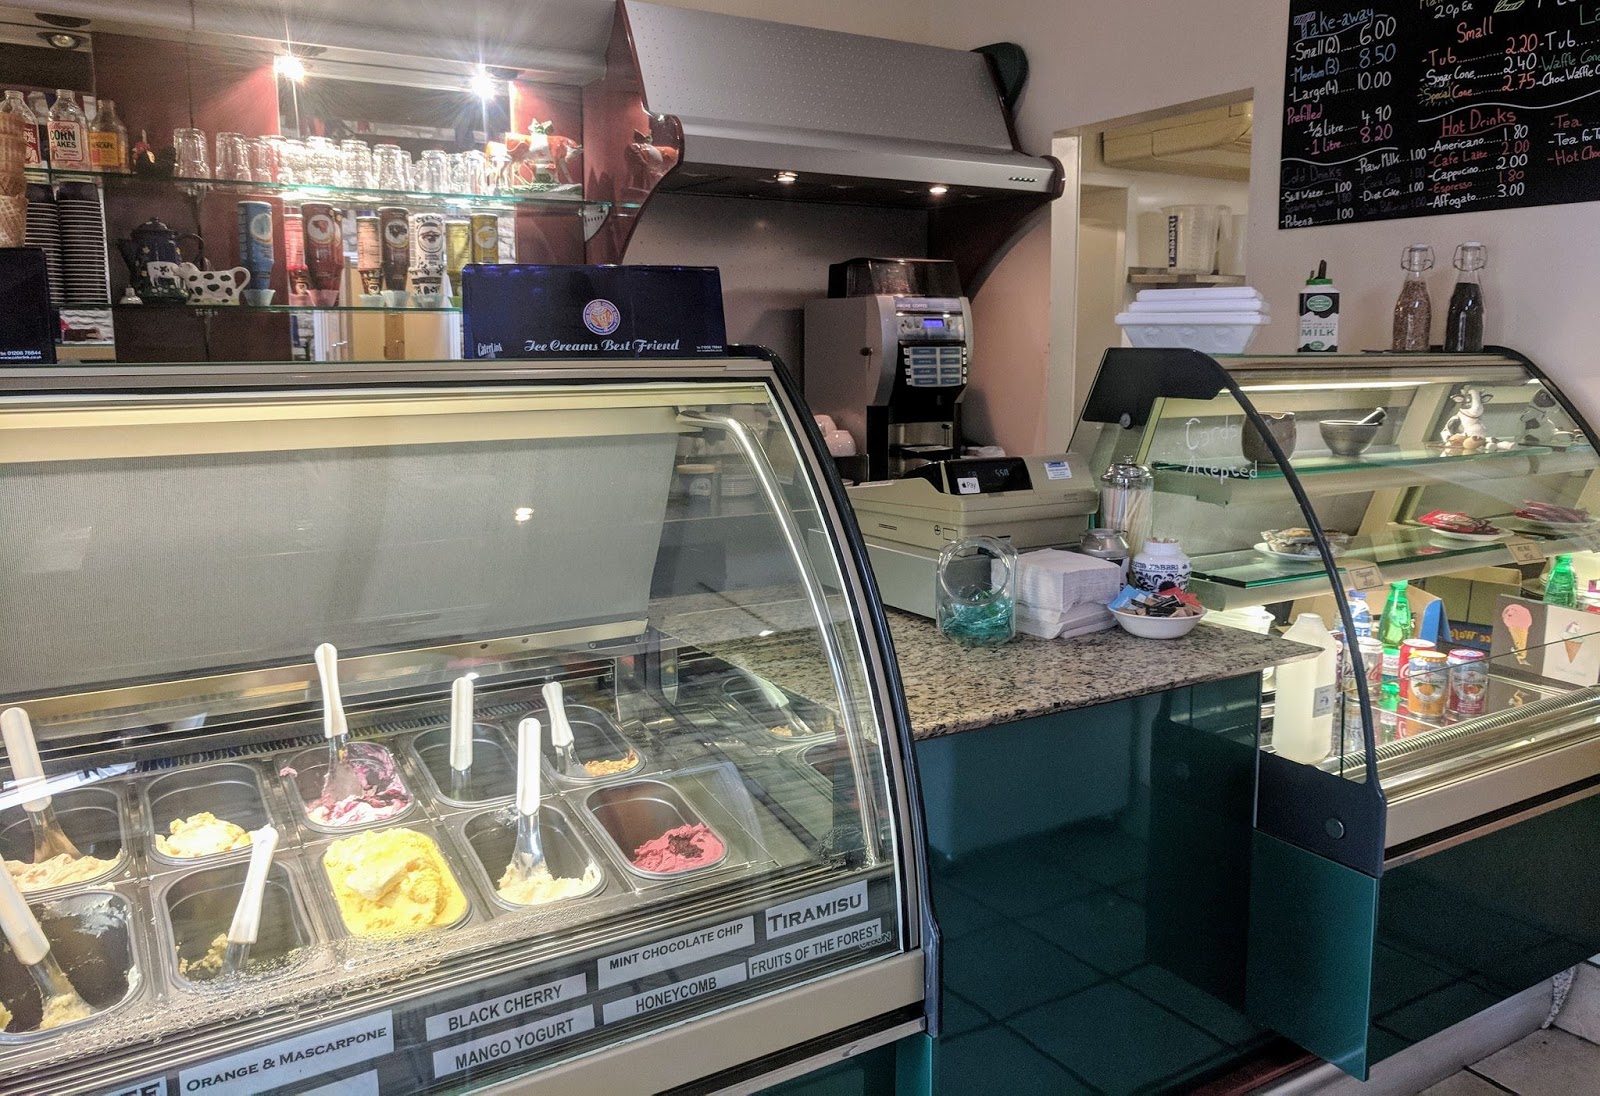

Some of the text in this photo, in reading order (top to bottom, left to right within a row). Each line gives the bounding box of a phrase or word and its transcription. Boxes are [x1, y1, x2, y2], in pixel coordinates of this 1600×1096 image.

[1434, 4, 1460, 19] 20p
[1360, 16, 1397, 45] 6.00
[1456, 15, 1494, 43] Small
[1544, 29, 1576, 51] Tub
[1359, 42, 1397, 69] 8.50
[1428, 33, 1538, 66] Tub 2.20
[1541, 51, 1576, 72] Waffle
[1357, 71, 1392, 91] 10.00
[1426, 52, 1538, 87] Sugar Cone 2.40
[1541, 71, 1566, 87] Choc
[1565, 64, 1594, 81] Waffle
[1452, 84, 1473, 99] Cone
[1501, 70, 1536, 92] 2.75
[1286, 103, 1323, 126] Prefilled
[1361, 104, 1392, 126] 4.90
[1441, 107, 1517, 138] Hot Drinks
[1554, 113, 1583, 129] Tea
[49, 129, 76, 141] CORN
[1322, 137, 1342, 153] litre
[1359, 123, 1393, 144] 8.20
[1433, 124, 1529, 153] Americano 1.80
[1553, 132, 1579, 147] Tea
[1581, 128, 1594, 142] for
[1359, 148, 1427, 175] Raw Milk 1.00
[1433, 138, 1530, 168] Cafe Latte 2.00
[1554, 149, 1580, 166] Hot
[1432, 153, 1529, 183] Cappucino 2.00
[1433, 168, 1525, 195] Espresso 1.80
[1300, 188, 1324, 199] Water
[1335, 181, 1353, 194] 1.00
[1363, 181, 1425, 202] Diet Coke 1.00
[1432, 182, 1526, 209] Affogato 3.00
[1284, 214, 1314, 229] Ribena
[1336, 207, 1354, 221] 1.00
[523, 339, 548, 352] Ice
[549, 338, 600, 352] Creams
[600, 338, 632, 352] Best
[631, 338, 681, 353] Friend
[1301, 328, 1335, 337] MILK
[1185, 415, 1239, 451] Cards
[1184, 455, 1258, 485] Accepted
[966, 481, 977, 490] Pay
[767, 893, 862, 932] TIRAMISU
[609, 923, 744, 971] MINT CHOCOLATE CHIP
[751, 923, 880, 976] FRUITS OF THE FOREST
[448, 984, 563, 1032] BLACK CHERRY
[635, 977, 717, 1013] HONEYCOMB
[455, 1017, 575, 1070] MANGO YOGURT
[186, 1063, 260, 1092] ORANGE
[262, 1058, 276, 1071] &
[279, 1027, 388, 1067] MASCARPONE
